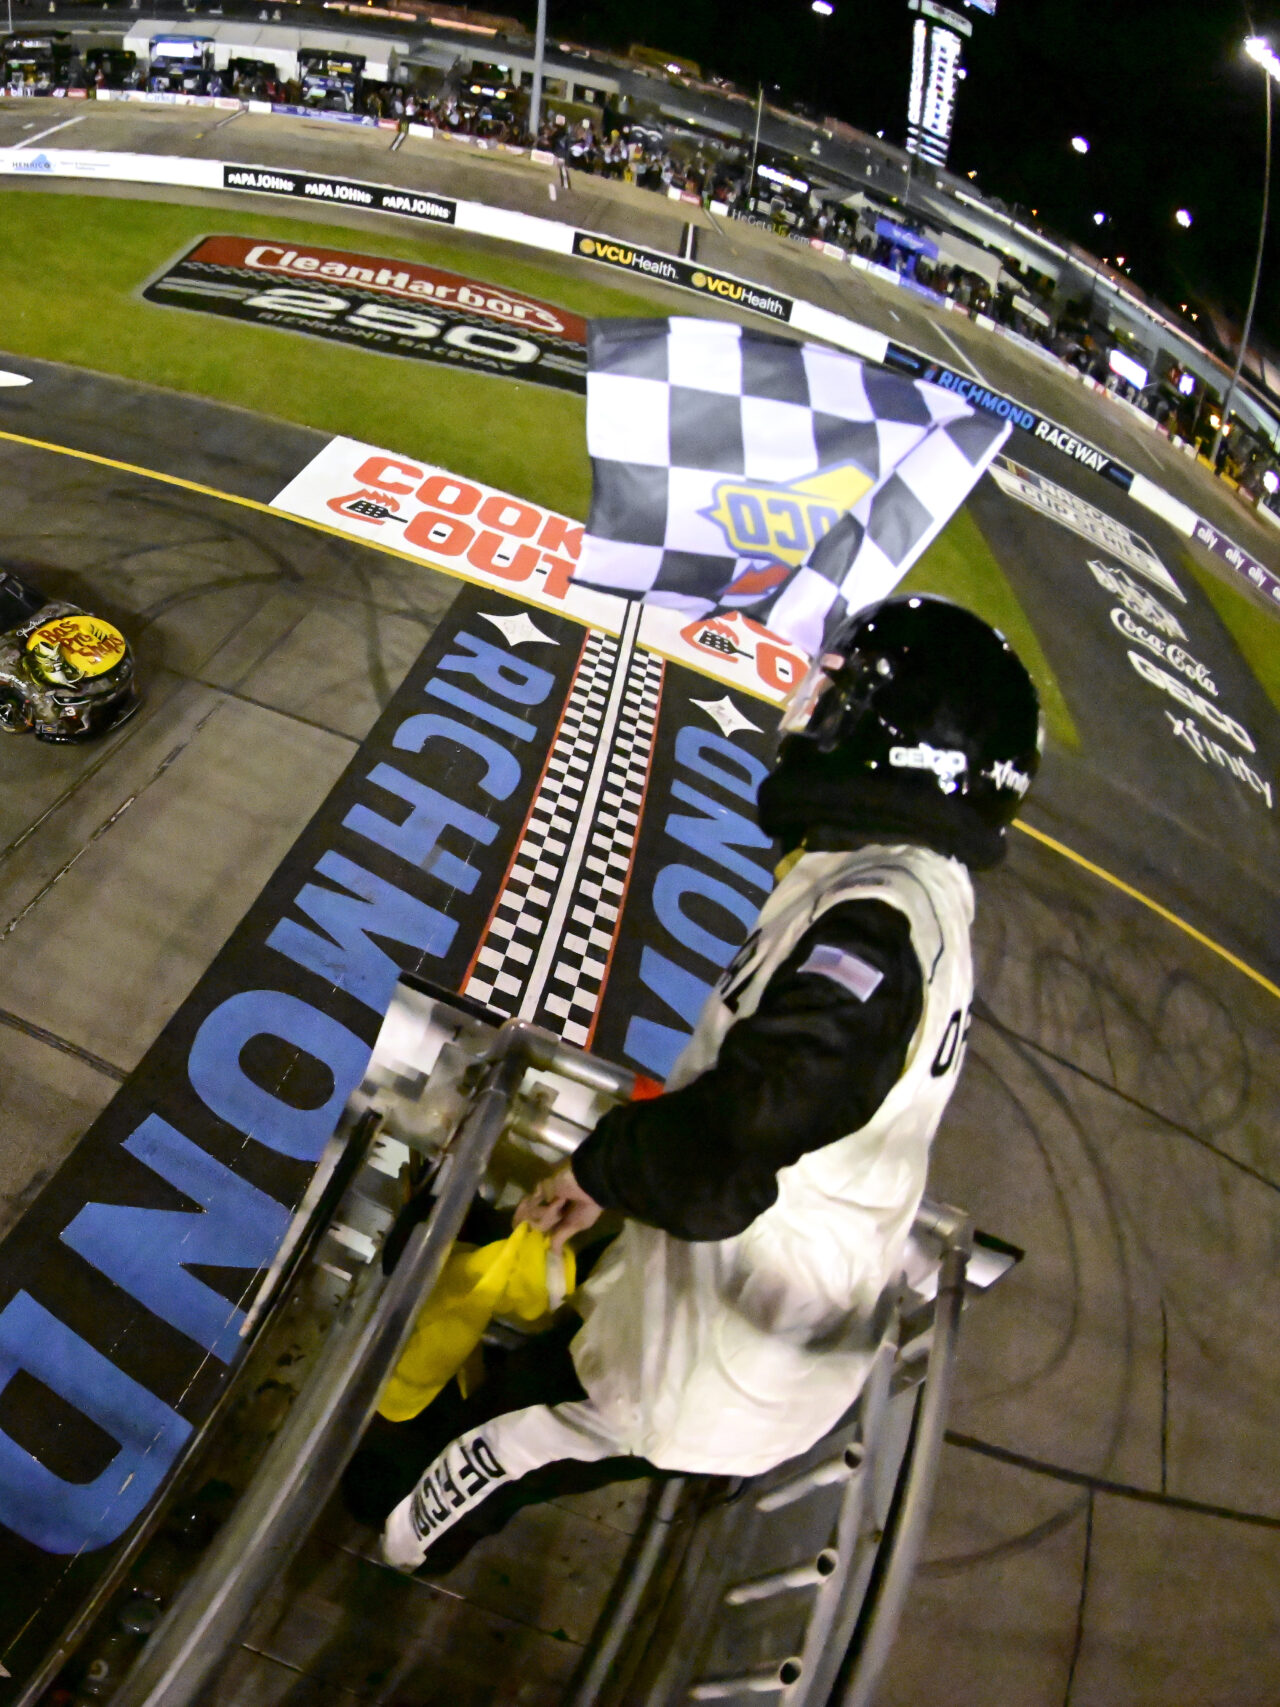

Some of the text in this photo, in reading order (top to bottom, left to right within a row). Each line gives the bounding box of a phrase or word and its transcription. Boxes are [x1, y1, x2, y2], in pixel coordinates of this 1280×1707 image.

[595, 242, 677, 279] VCU Health
[707, 275, 784, 315] VCU Health
[243, 288, 540, 363] 250
[938, 370, 1110, 473] RICHMOND RACEWAY
[353, 456, 585, 560] COOK
[404, 511, 576, 600] OUT
[1197, 527, 1218, 550] ally
[1225, 548, 1245, 570] ally
[1248, 566, 1267, 588] ally
